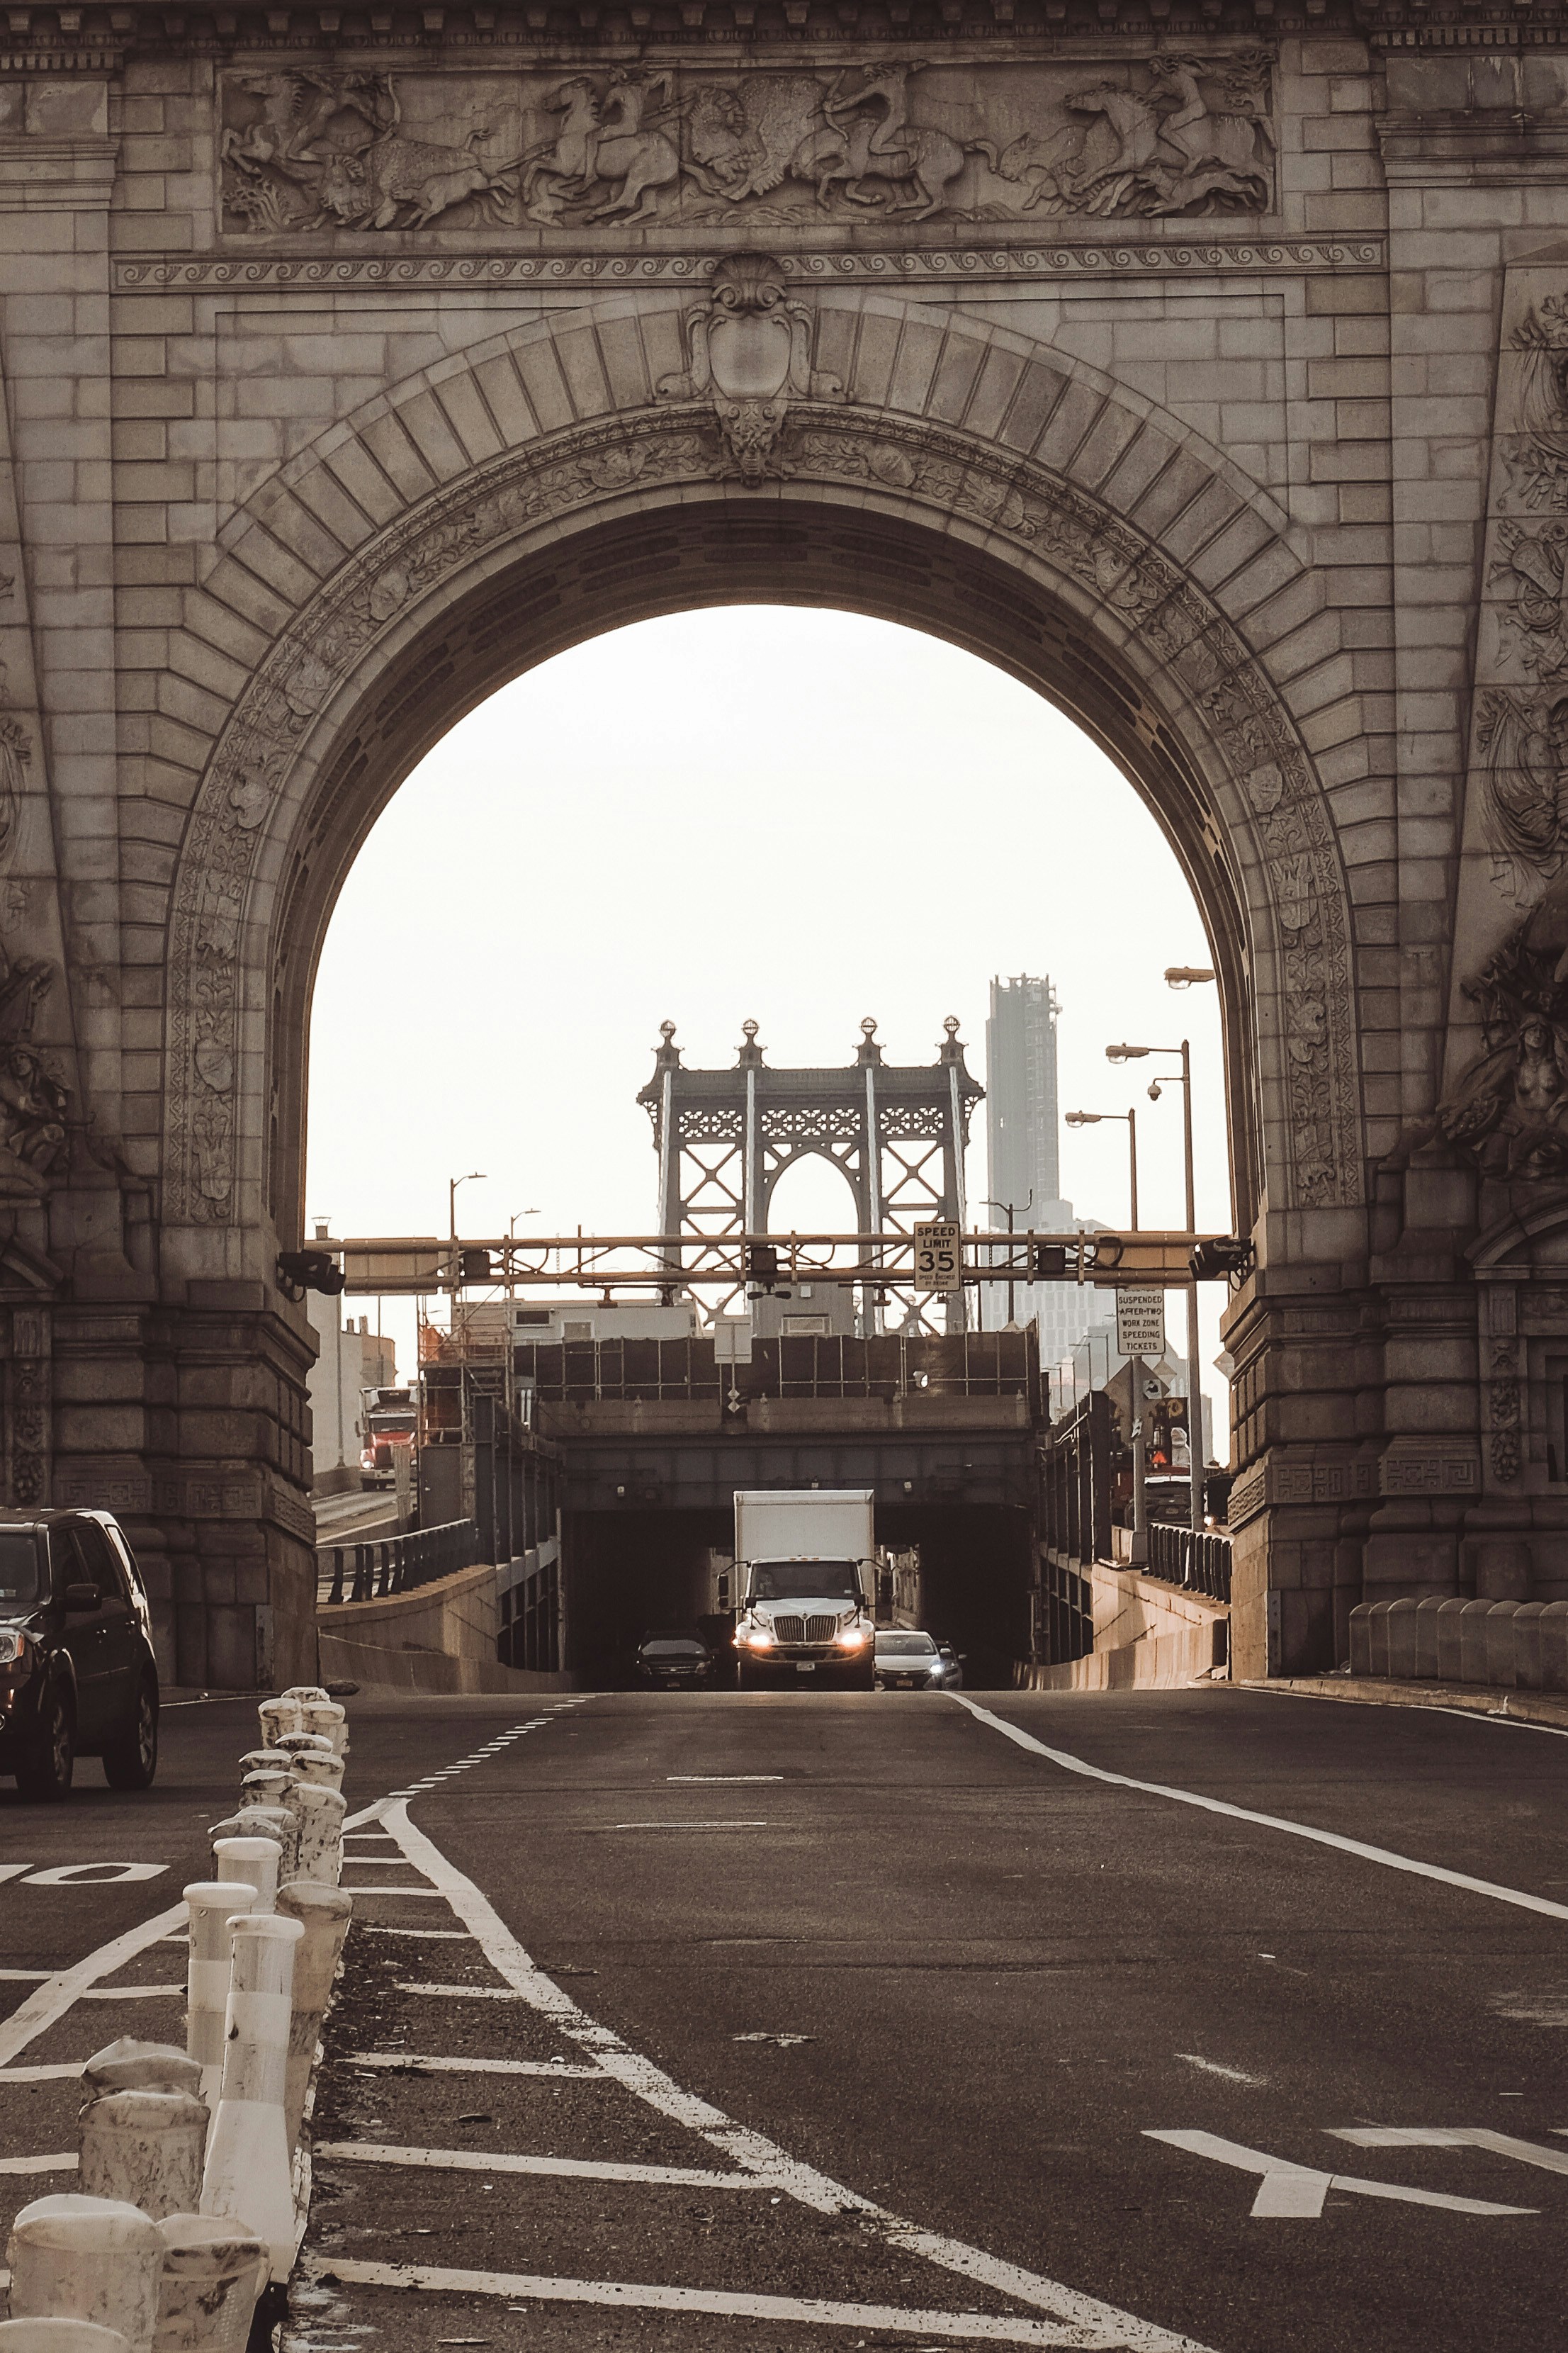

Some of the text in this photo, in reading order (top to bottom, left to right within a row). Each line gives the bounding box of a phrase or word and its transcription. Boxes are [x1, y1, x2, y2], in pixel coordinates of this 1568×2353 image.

[918, 1228, 955, 1236] SPEED
[923, 1240, 951, 1248] LIMIT
[918, 1251, 954, 1272] 35
